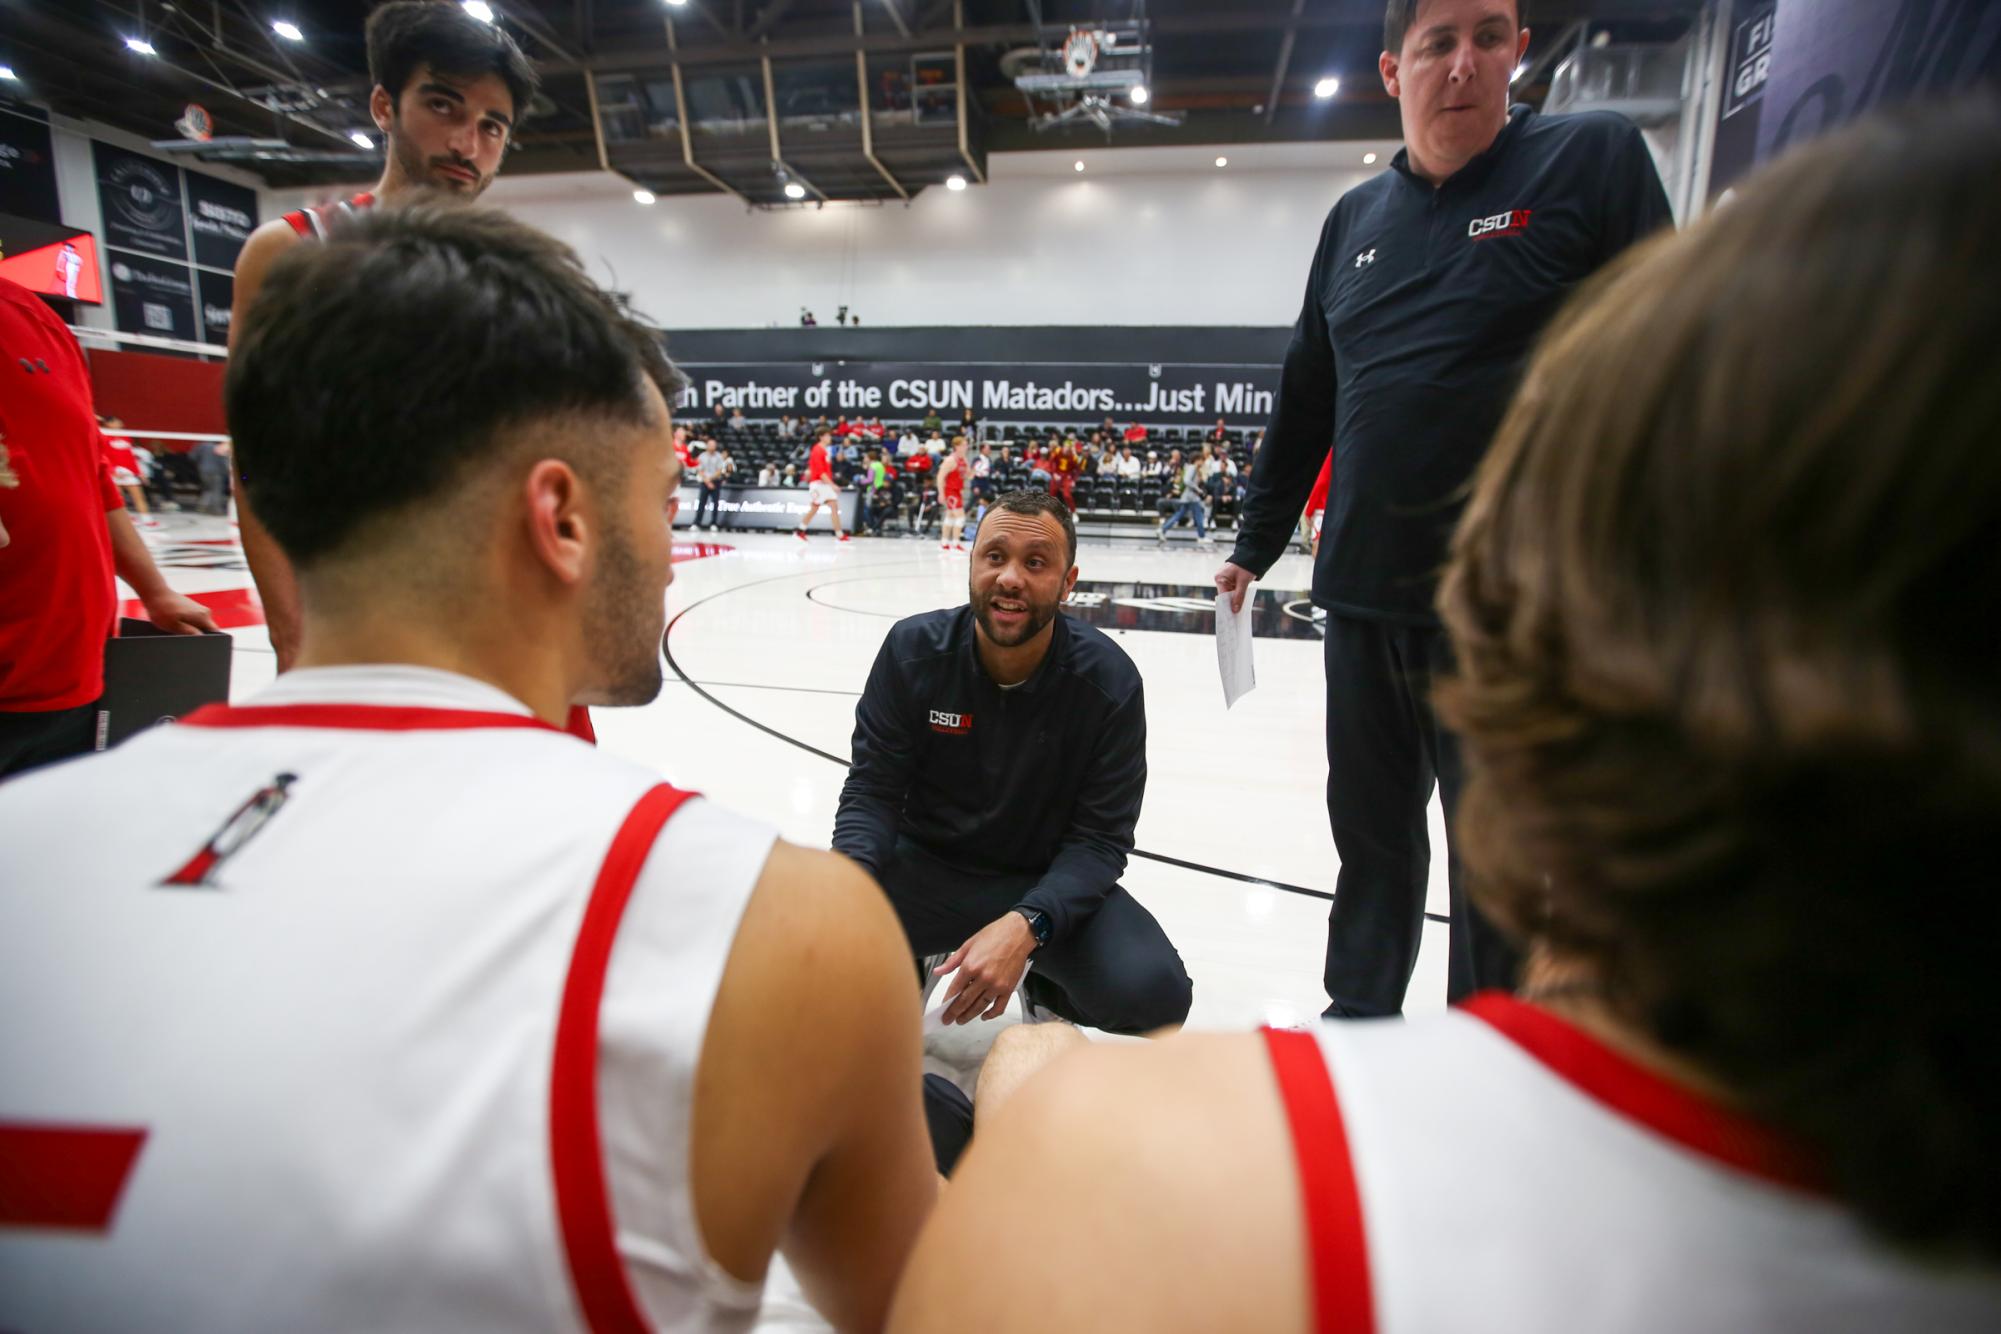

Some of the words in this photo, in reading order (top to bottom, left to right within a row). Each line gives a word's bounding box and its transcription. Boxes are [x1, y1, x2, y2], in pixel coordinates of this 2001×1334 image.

[1746, 14, 1773, 55] FI
[1468, 210, 1532, 237] CSUN
[705, 380, 799, 409] Partner
[804, 380, 832, 408] of
[836, 380, 882, 408] the
[888, 380, 974, 409] CSUN
[1214, 382, 1277, 414] Min
[929, 709, 973, 728] CSUN
